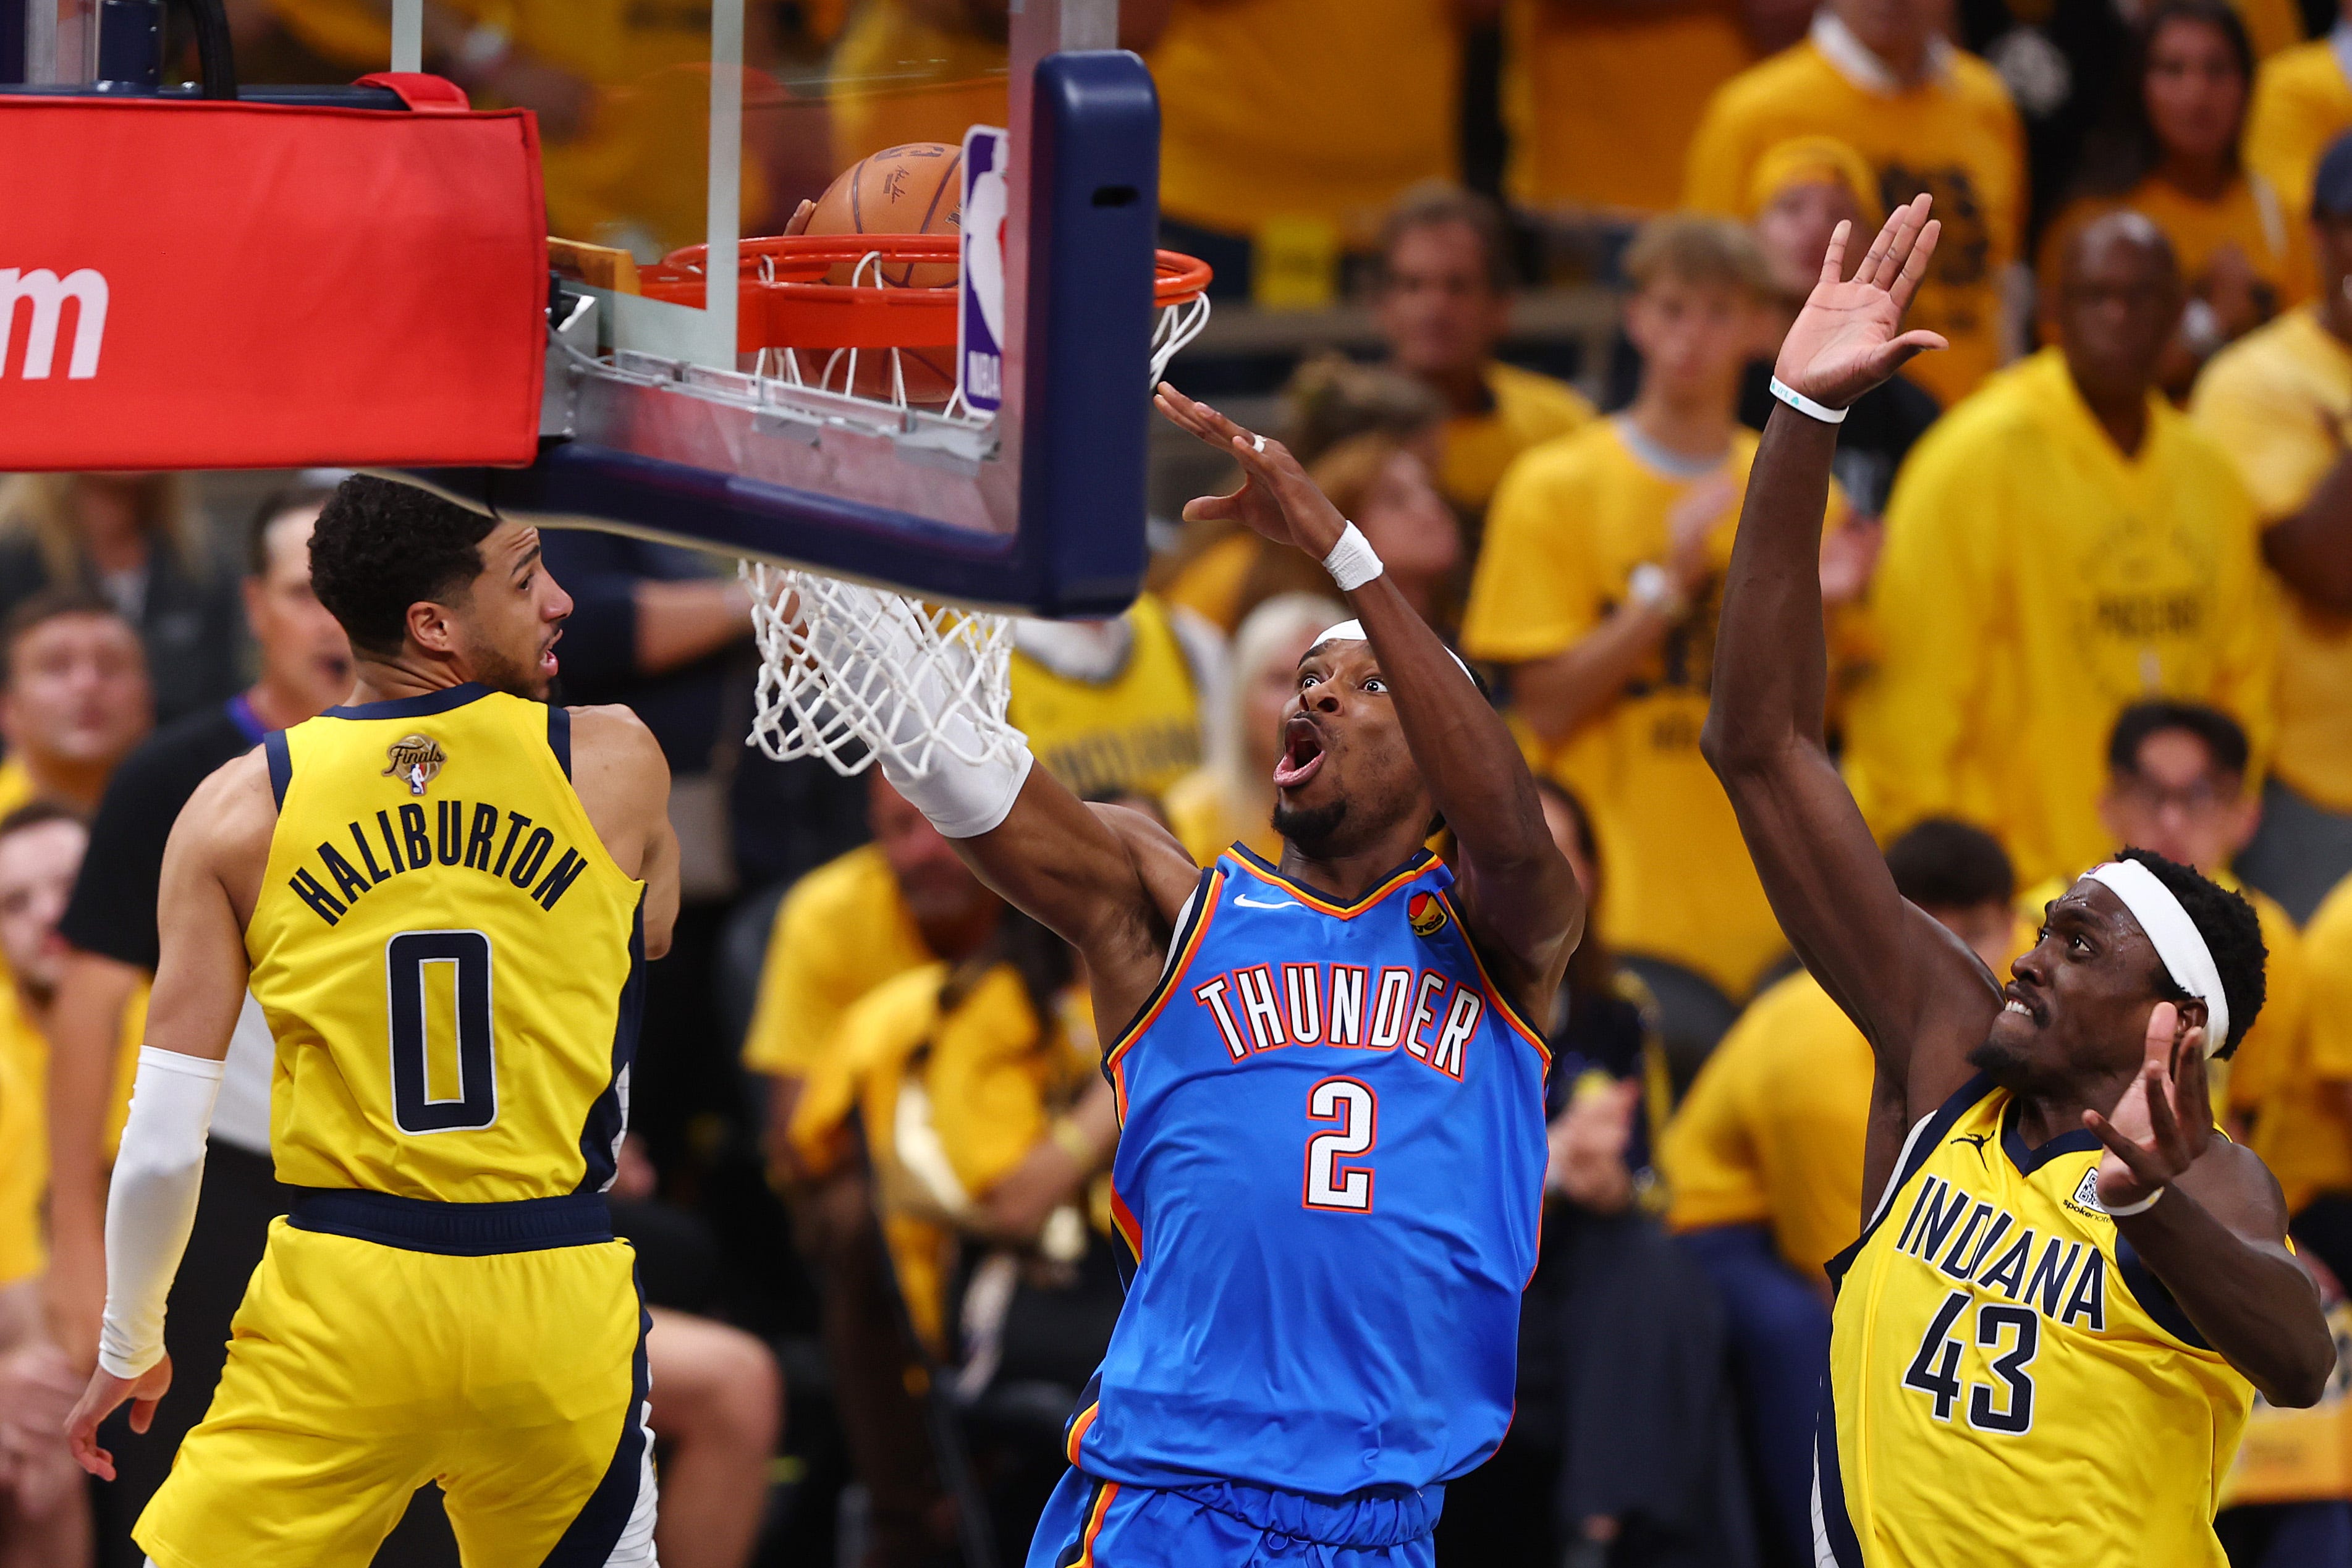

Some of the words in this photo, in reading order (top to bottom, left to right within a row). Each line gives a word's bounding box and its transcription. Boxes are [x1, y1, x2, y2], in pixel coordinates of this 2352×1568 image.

[384, 743, 445, 774] Finals
[288, 801, 588, 927] HALIBURTON
[386, 929, 497, 1136] 0
[1191, 963, 1486, 1083] THUNDER
[1302, 1076, 1377, 1215] 2
[1894, 1173, 2107, 1333] INDIANA
[1901, 1289, 2041, 1437] 43
